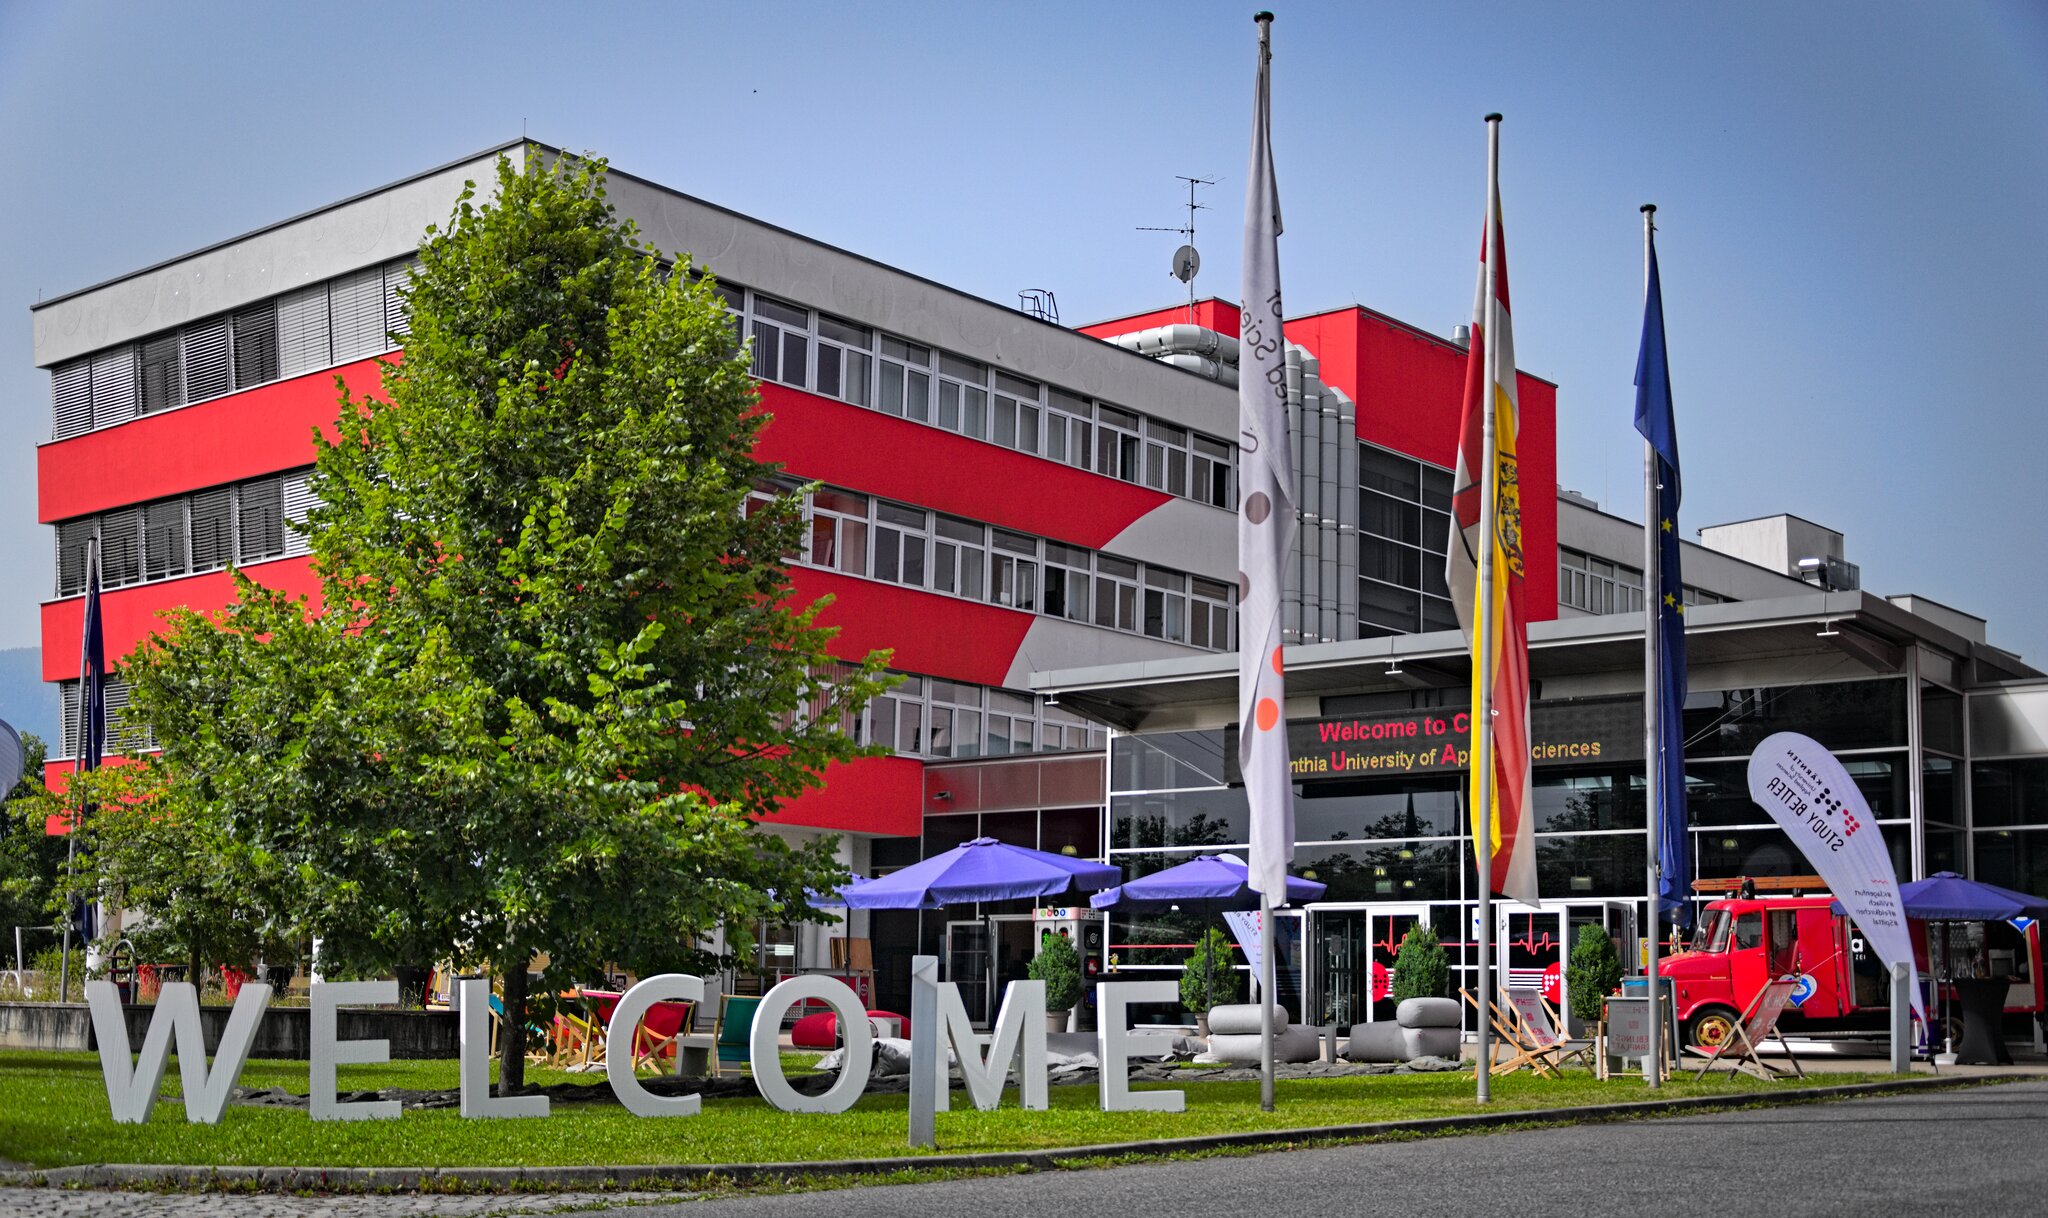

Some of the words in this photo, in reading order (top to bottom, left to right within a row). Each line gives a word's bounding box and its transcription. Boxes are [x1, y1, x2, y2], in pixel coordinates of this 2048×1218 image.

[1318, 720, 1417, 743] Welcome
[1424, 716, 1446, 735] to
[1289, 757, 1328, 773] nthia
[1331, 749, 1415, 771] University
[1419, 749, 1437, 766] of
[1532, 741, 1601, 759] ciences
[86, 973, 1186, 1124] WELCOME
